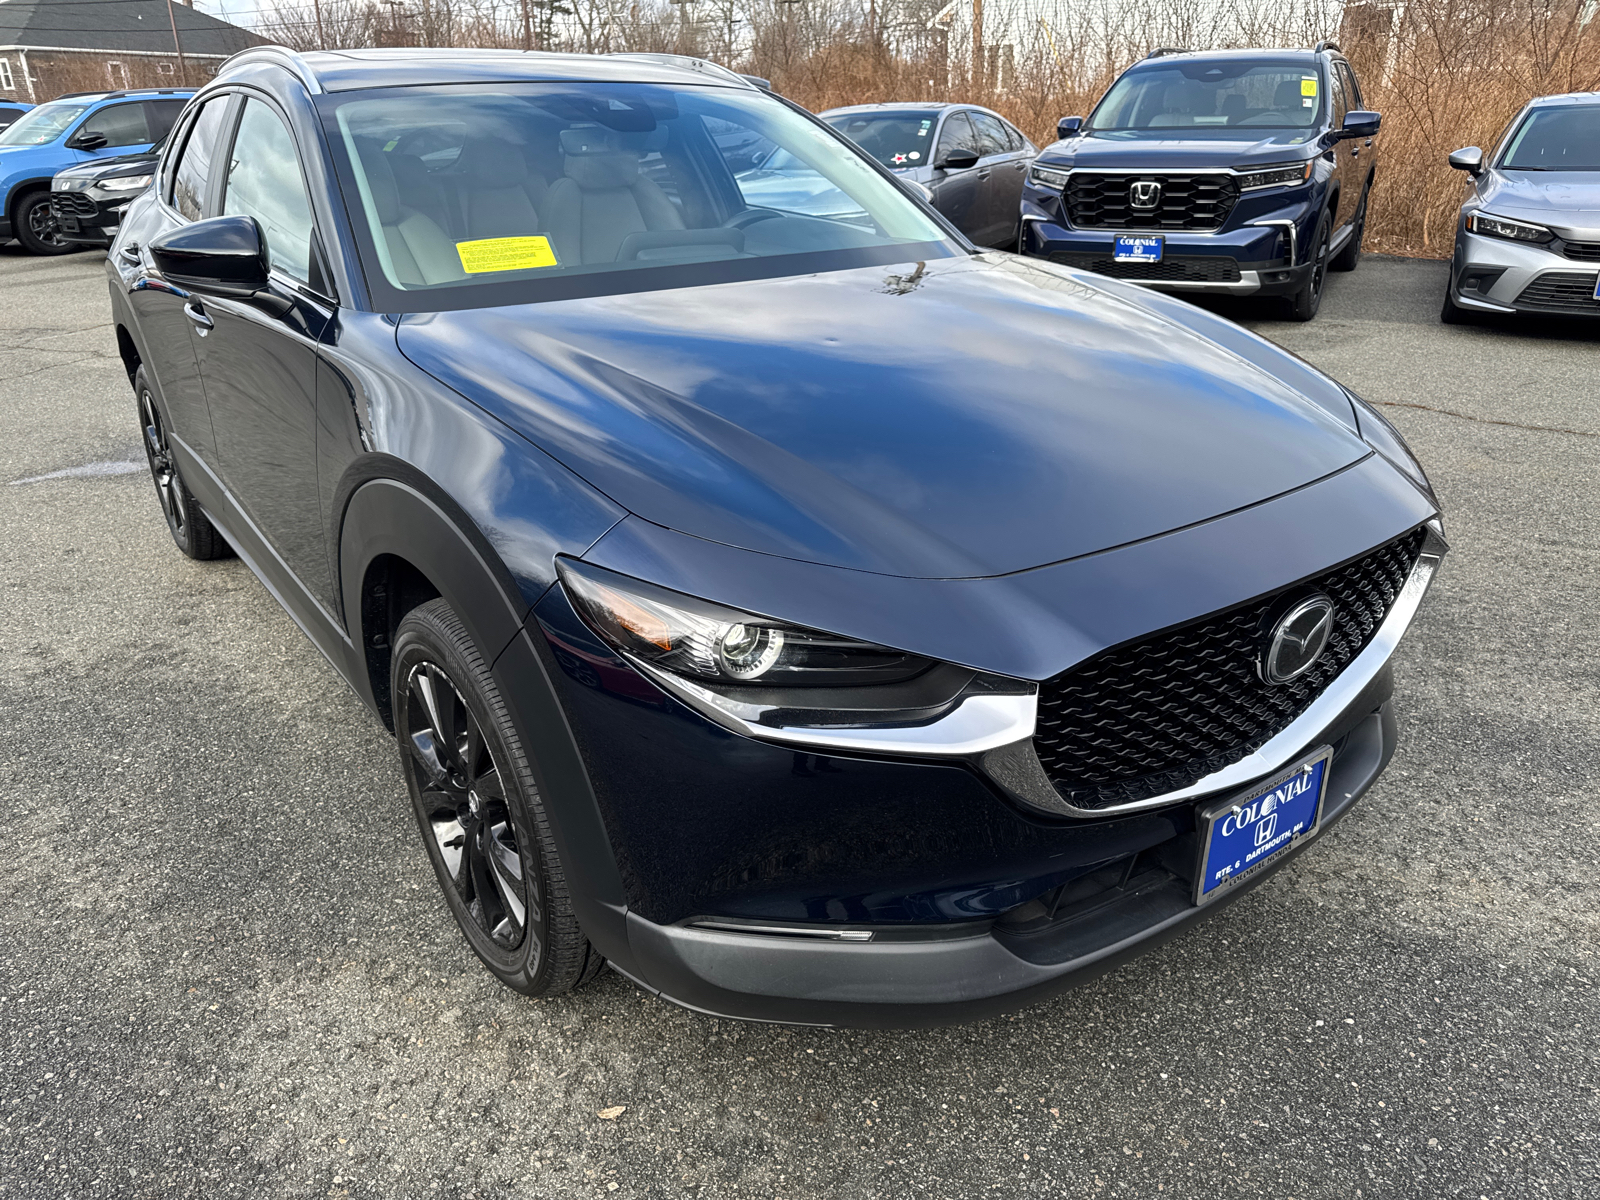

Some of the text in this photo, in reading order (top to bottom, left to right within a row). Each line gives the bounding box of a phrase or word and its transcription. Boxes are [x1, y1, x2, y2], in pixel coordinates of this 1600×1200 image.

[1221, 774, 1313, 837] COLONIAL
[1215, 865, 1234, 880] RTE.
[1234, 860, 1241, 869] 6
[1245, 831, 1292, 863] DARTMOUTH,
[1292, 821, 1304, 833] MA
[1229, 844, 1292, 887] COLONIAL HONDA
